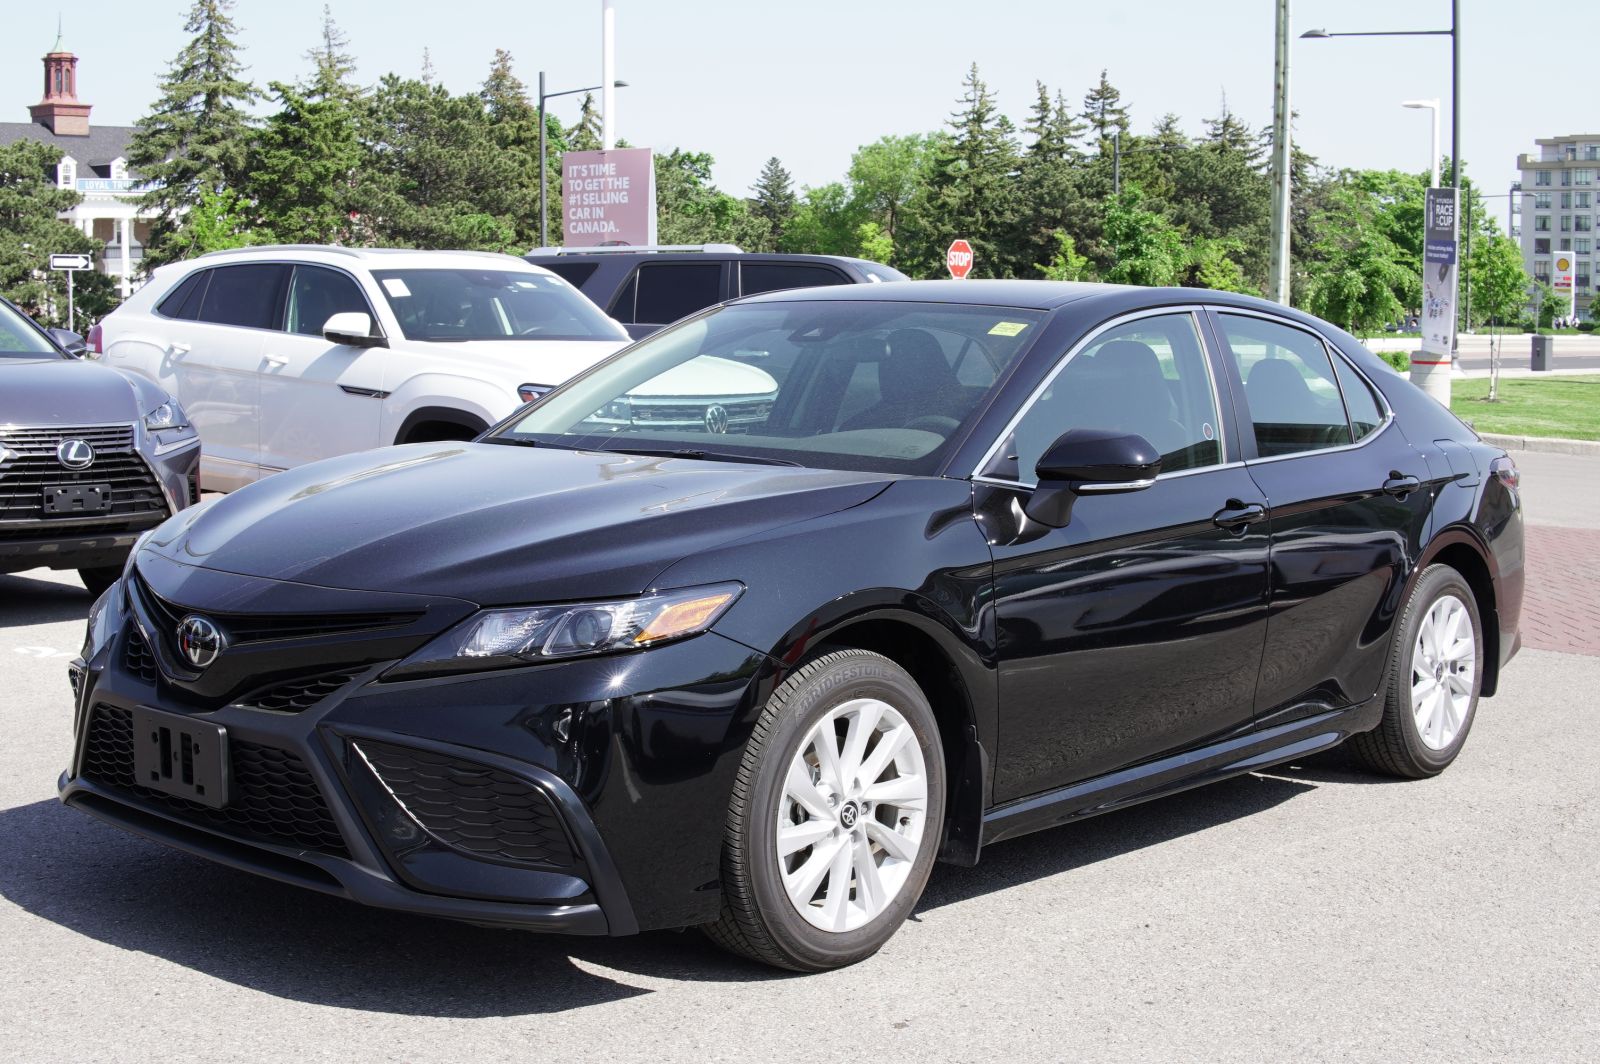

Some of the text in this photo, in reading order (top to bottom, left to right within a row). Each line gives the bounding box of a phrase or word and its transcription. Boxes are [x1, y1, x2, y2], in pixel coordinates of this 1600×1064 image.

[569, 163, 616, 178] IT'S TIME
[569, 176, 630, 192] TO GET THE
[569, 191, 629, 206] #1 SELLING
[569, 206, 604, 220] CAR IN
[1435, 204, 1453, 215] RACE
[569, 220, 620, 234] CANADA.
[1439, 216, 1453, 226] CUP
[949, 251, 971, 267] STOP
